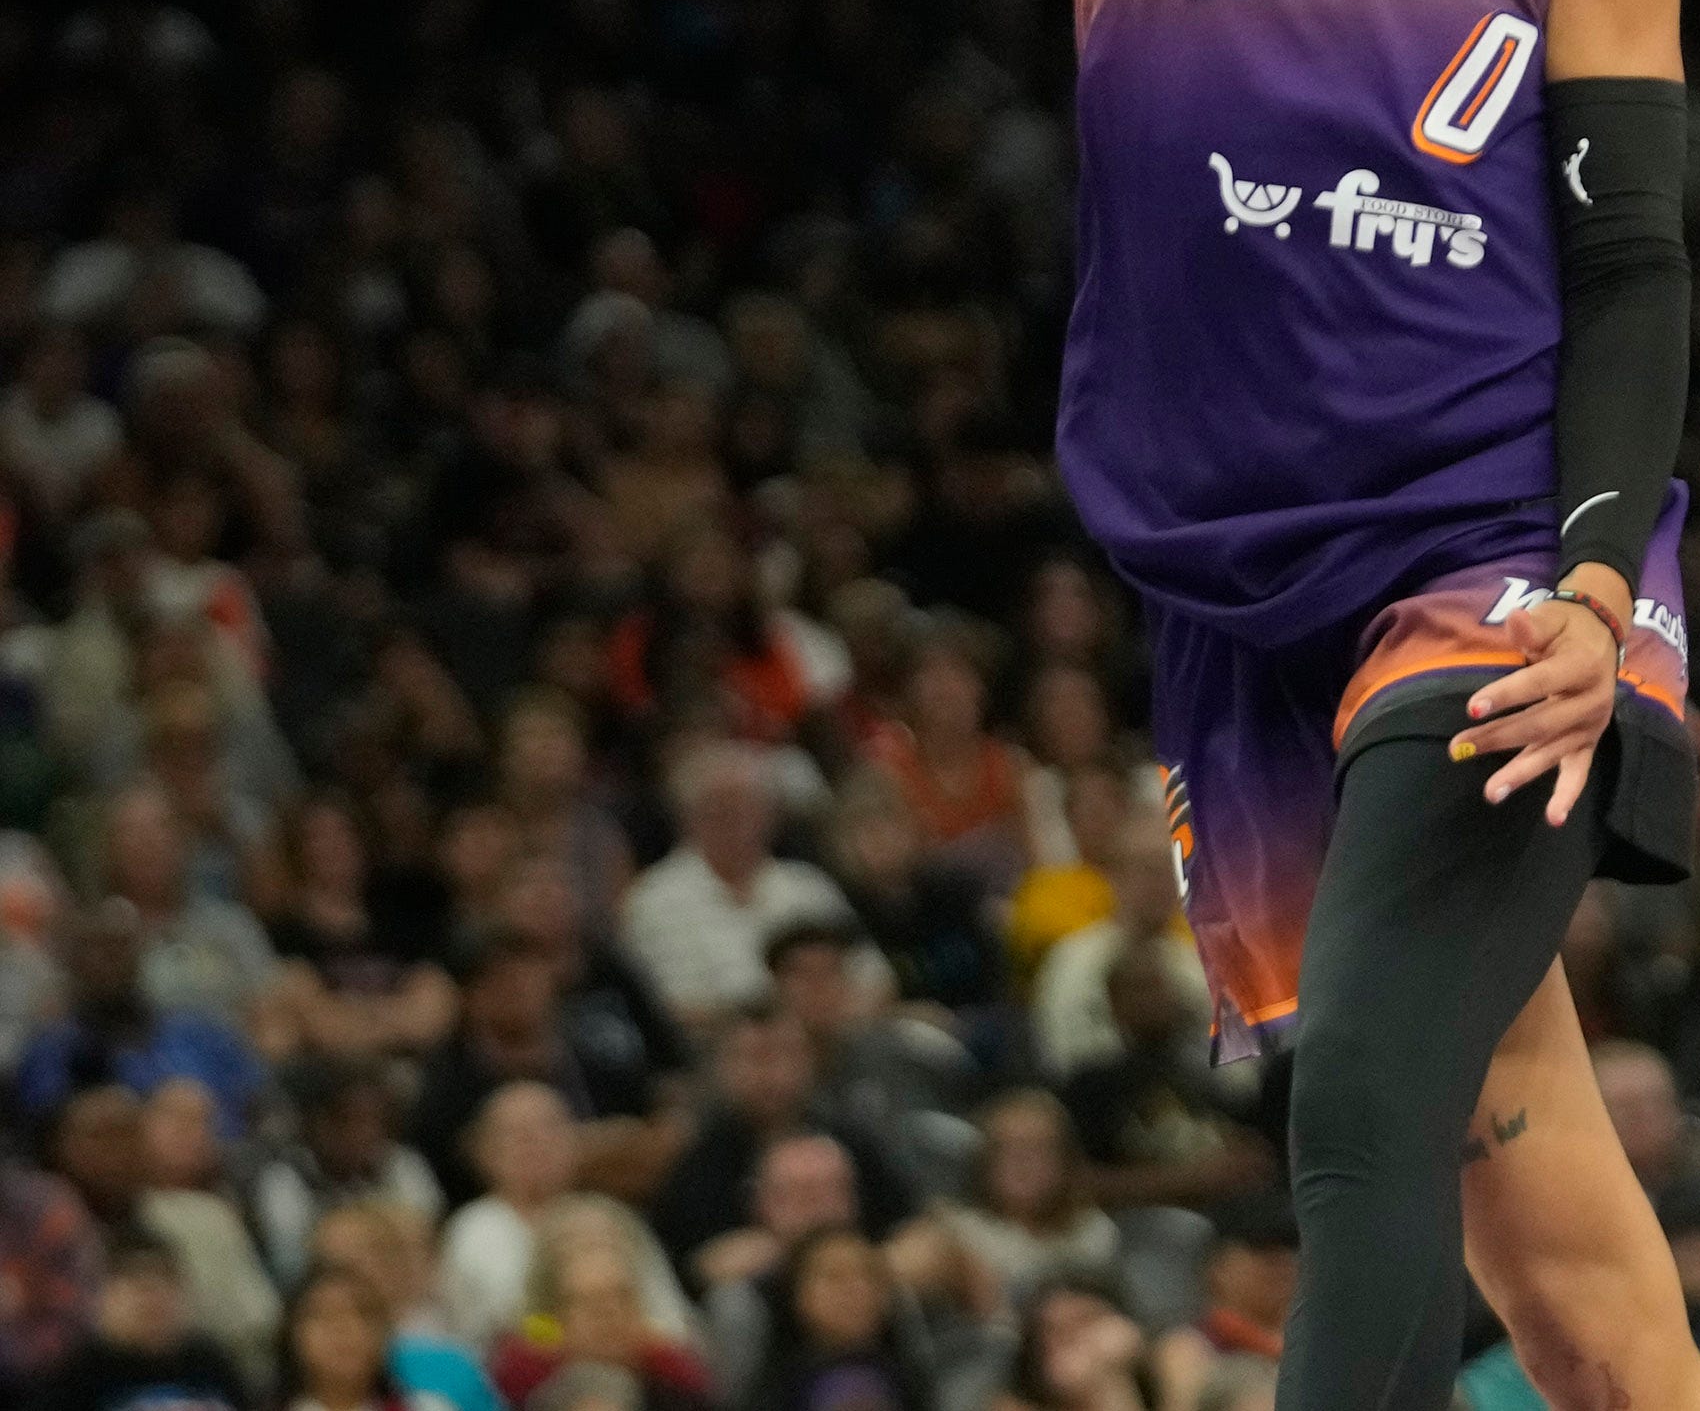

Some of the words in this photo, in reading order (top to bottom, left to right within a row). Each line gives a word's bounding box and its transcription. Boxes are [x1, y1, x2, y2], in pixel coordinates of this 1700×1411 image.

[1412, 9, 1539, 166] 0
[1313, 168, 1488, 269] fry's
[1361, 197, 1407, 216] FOOD
